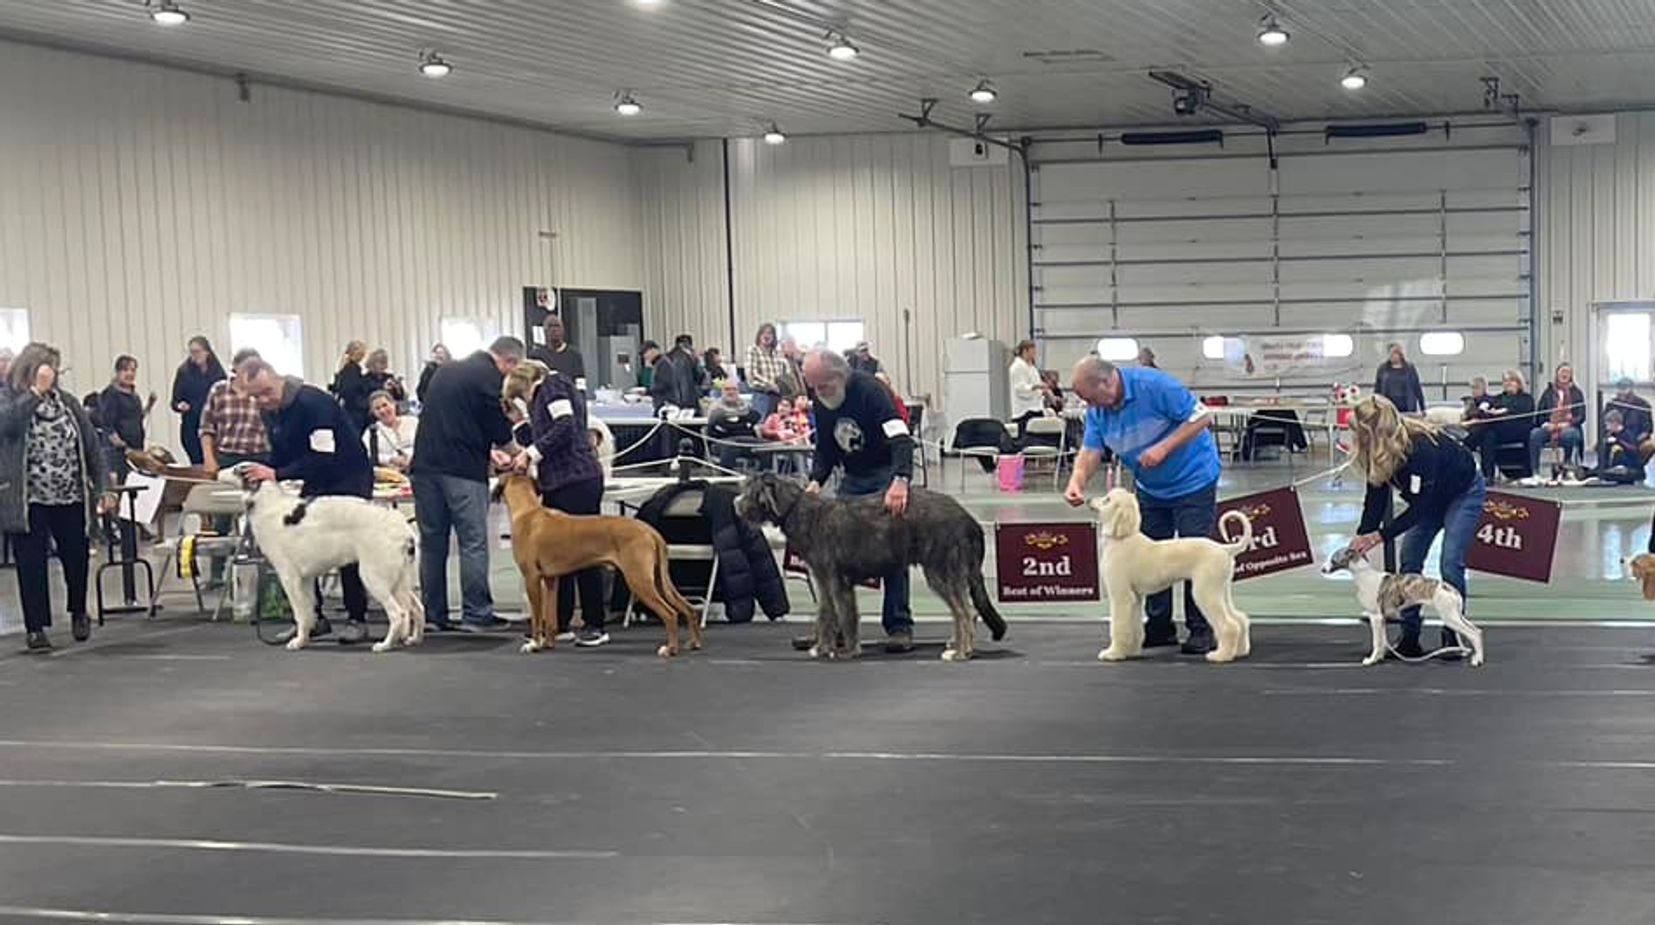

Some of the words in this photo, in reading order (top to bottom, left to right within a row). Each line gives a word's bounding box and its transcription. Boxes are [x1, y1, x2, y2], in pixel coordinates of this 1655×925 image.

[1476, 523, 1522, 550] 4th
[1023, 555, 1072, 576] 2nd
[1003, 586, 1027, 596] Best
[1029, 585, 1042, 595] of
[1042, 585, 1094, 596] Winners
